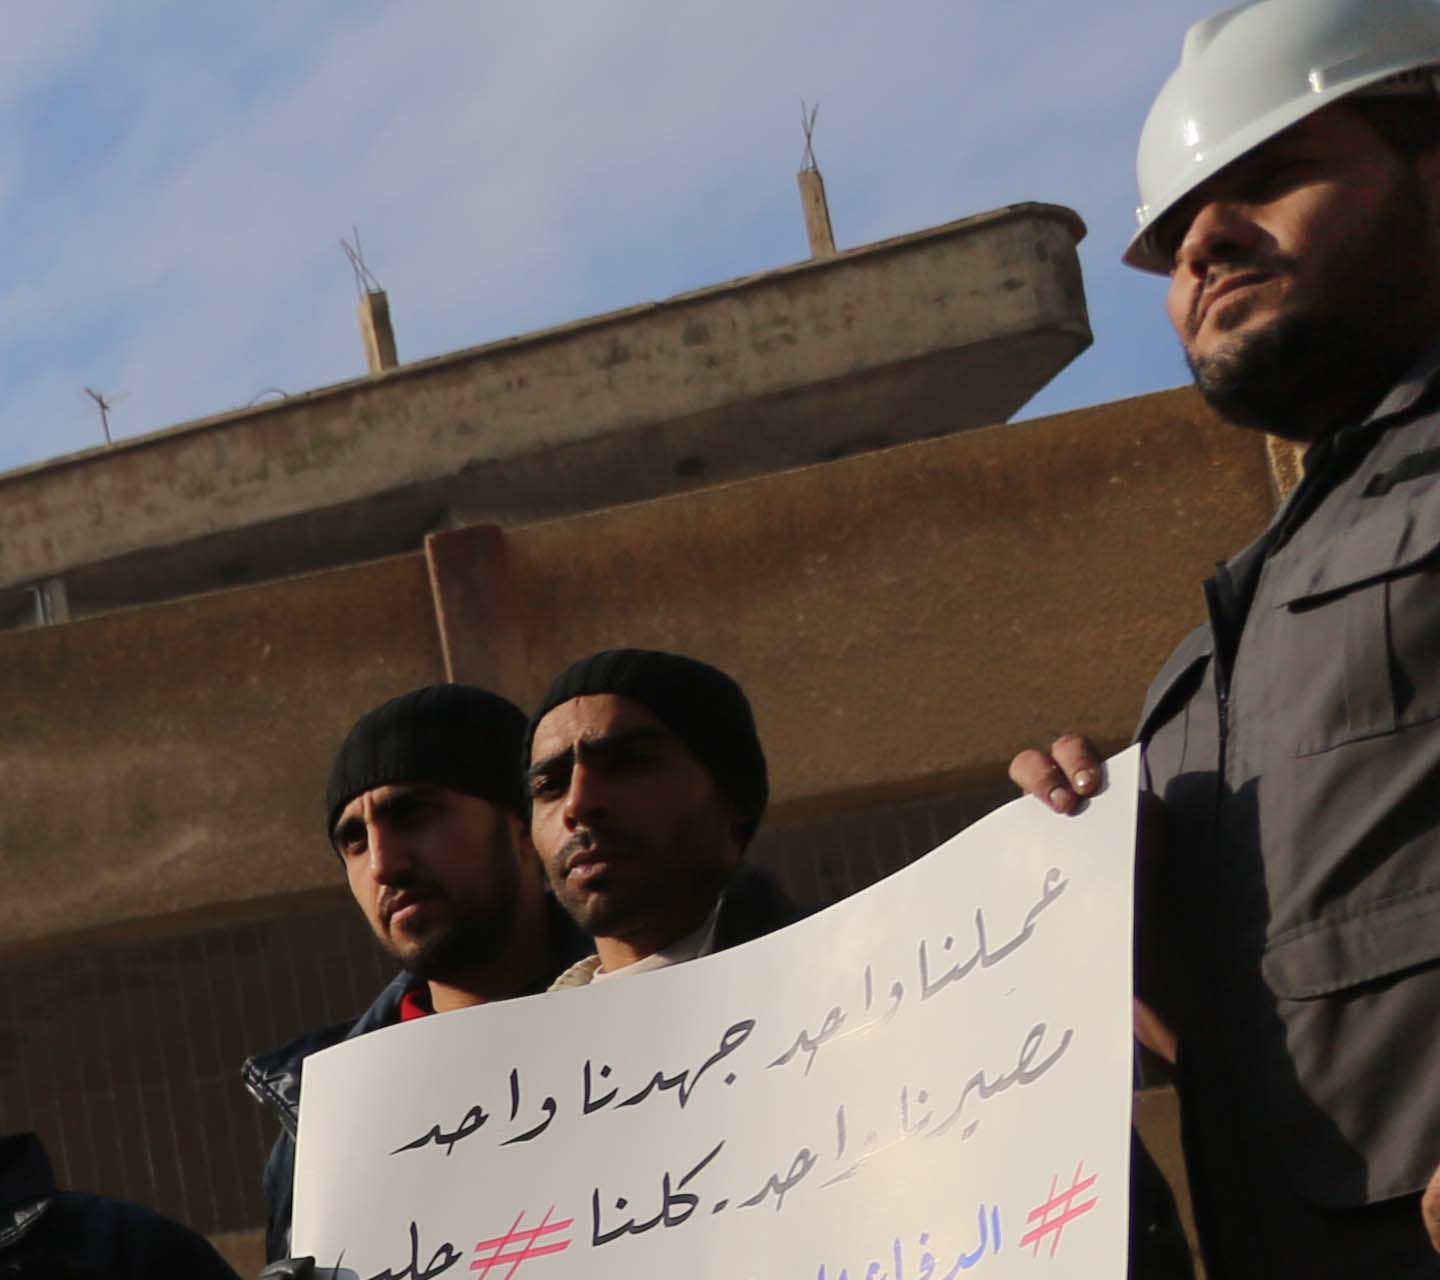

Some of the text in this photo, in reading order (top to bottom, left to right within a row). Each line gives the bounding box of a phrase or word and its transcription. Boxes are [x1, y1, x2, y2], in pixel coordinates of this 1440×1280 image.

[919, 867, 1071, 1000] عملنا
[389, 1067, 558, 1156] واحد
[583, 1019, 757, 1115] جهدنا
[592, 1140, 726, 1247] كلنا
